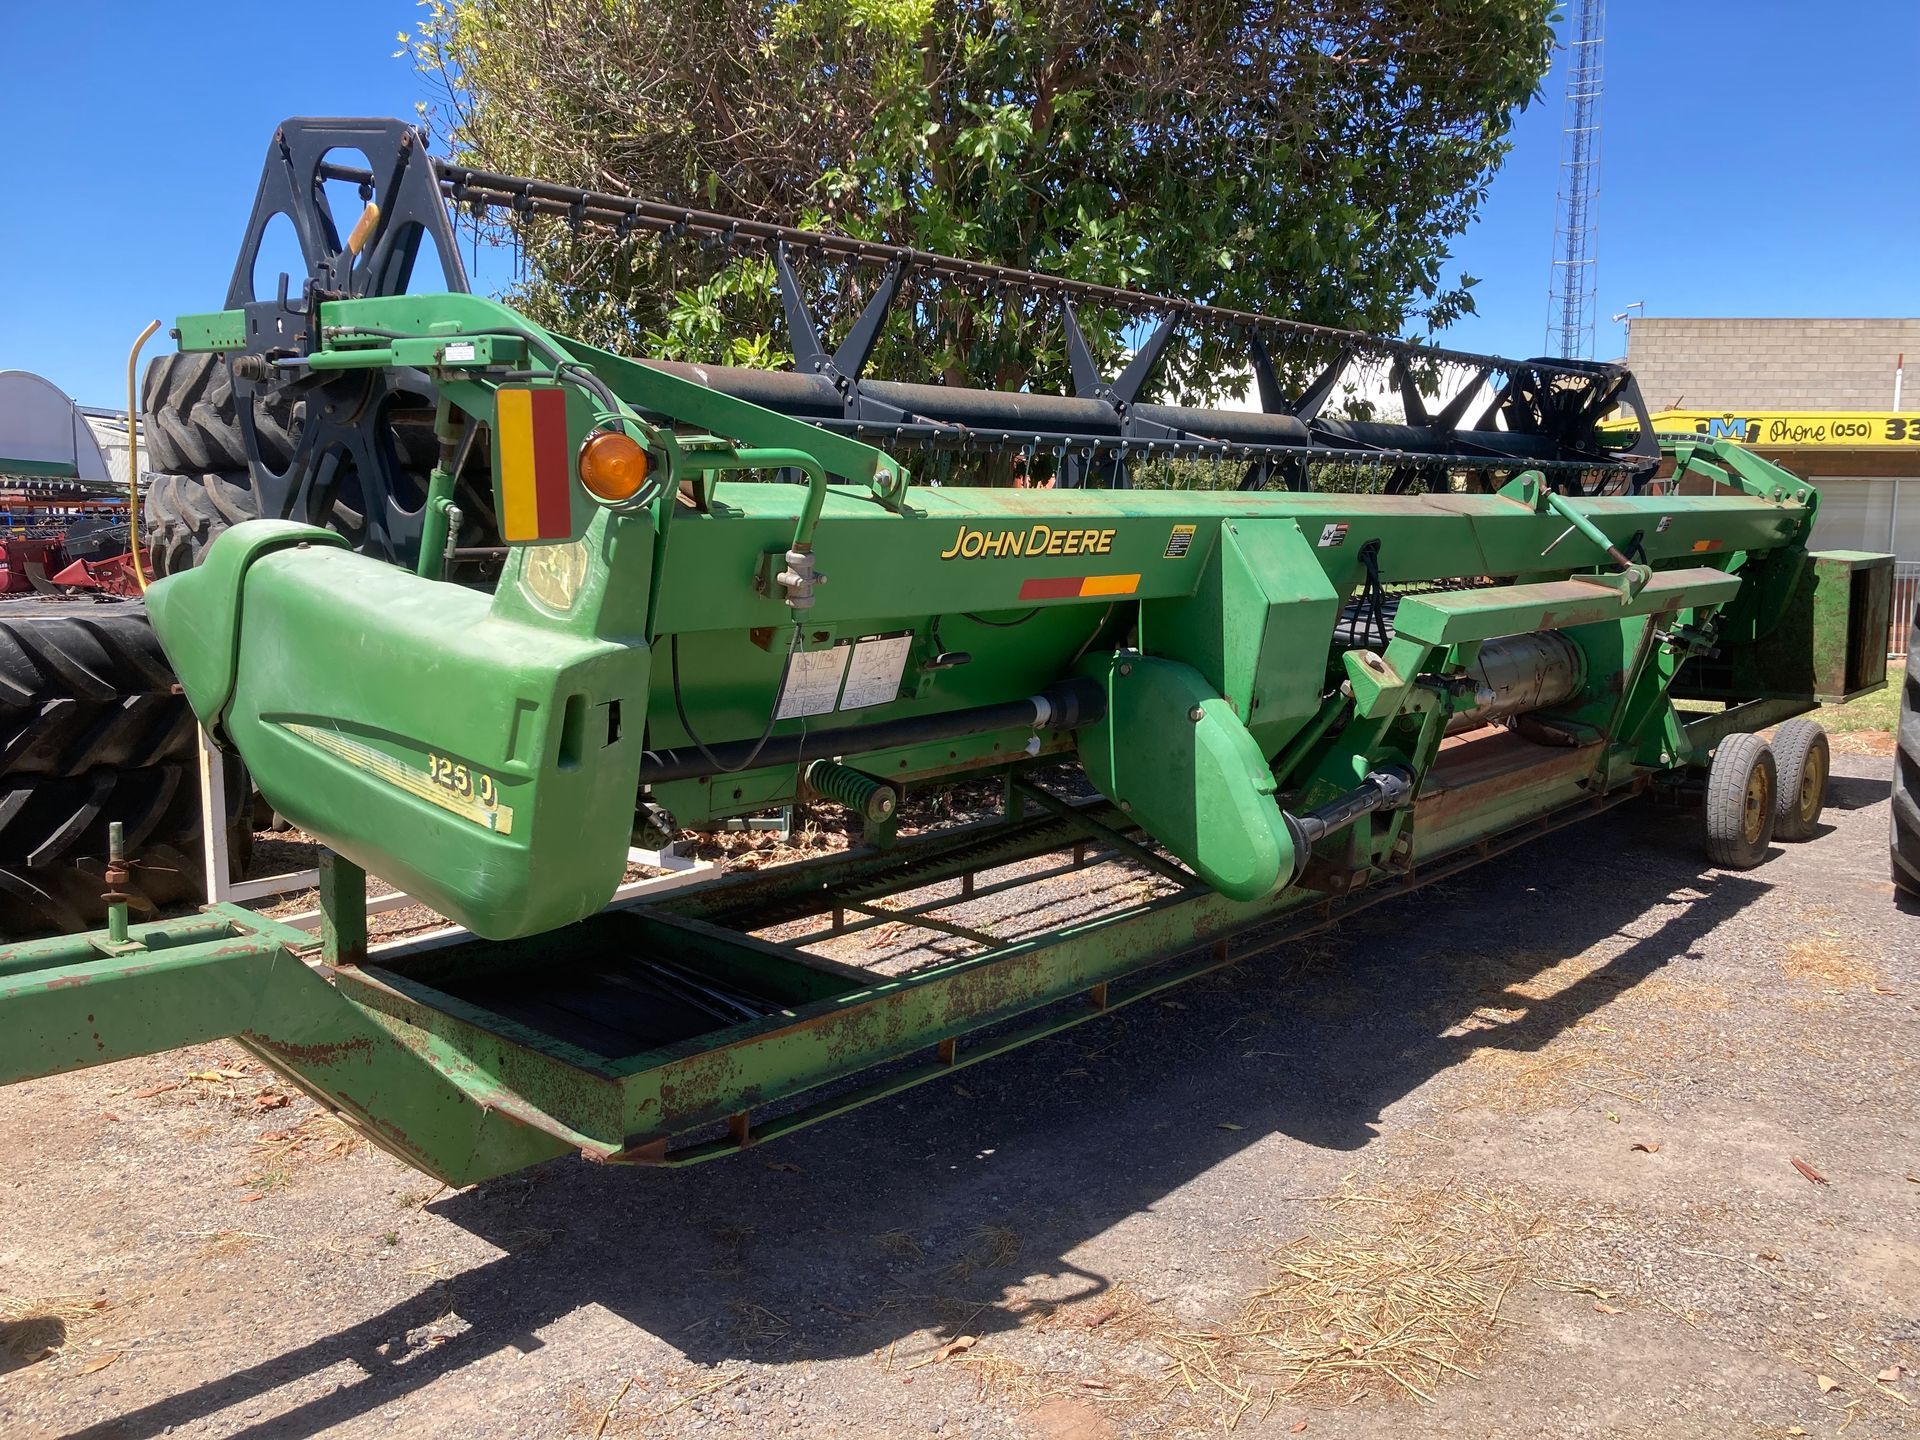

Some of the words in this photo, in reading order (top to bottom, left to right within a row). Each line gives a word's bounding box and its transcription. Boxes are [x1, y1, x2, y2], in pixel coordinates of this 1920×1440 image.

[1769, 418, 1825, 442] Phone
[1830, 421, 1872, 439] (050)
[941, 526, 1026, 560] JOHN
[1024, 524, 1117, 557] DEERE
